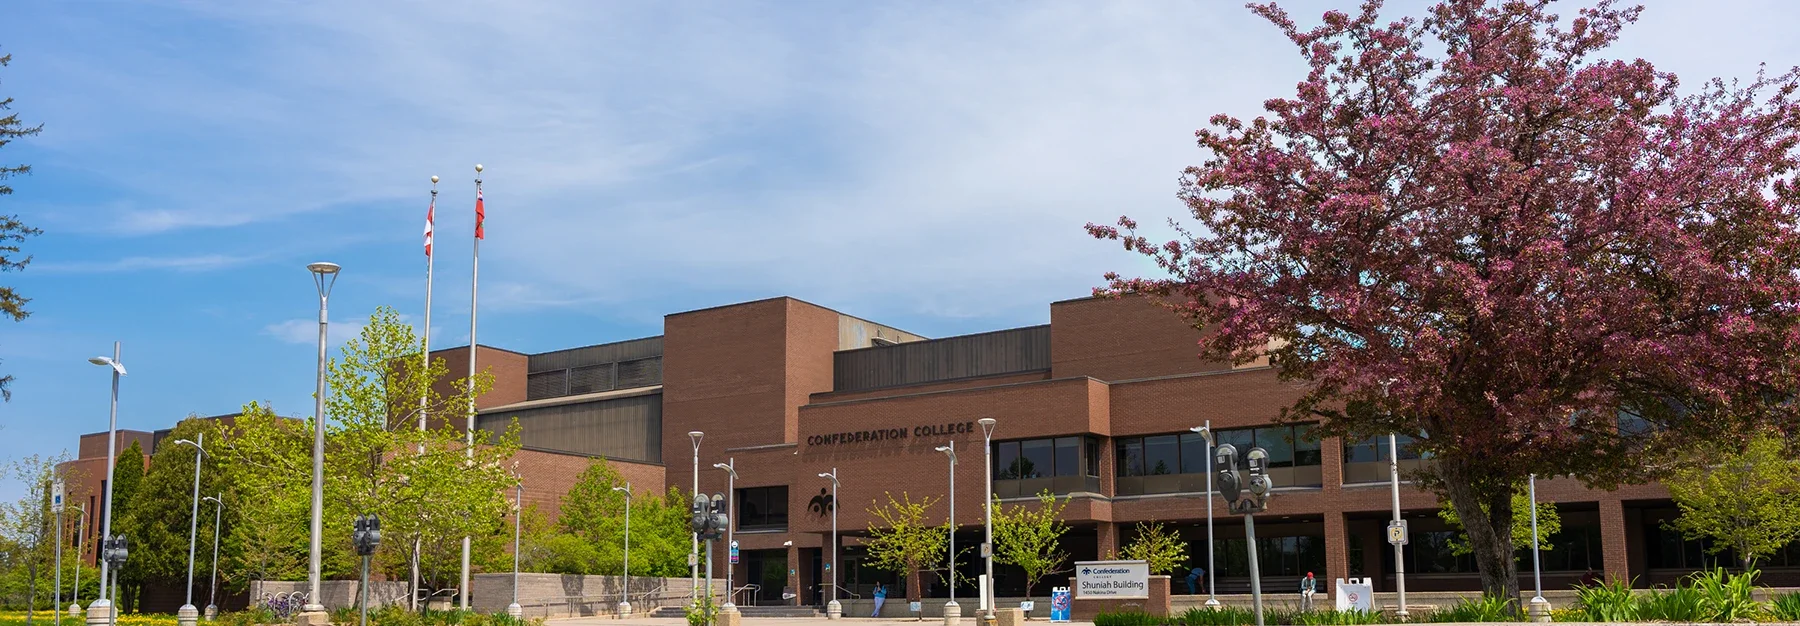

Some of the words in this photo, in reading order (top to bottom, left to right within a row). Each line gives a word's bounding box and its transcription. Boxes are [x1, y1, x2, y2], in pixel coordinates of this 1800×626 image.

[807, 427, 908, 446] CONFEDERATION
[914, 421, 974, 438] COLLEGE
[1113, 581, 1143, 590] Building
